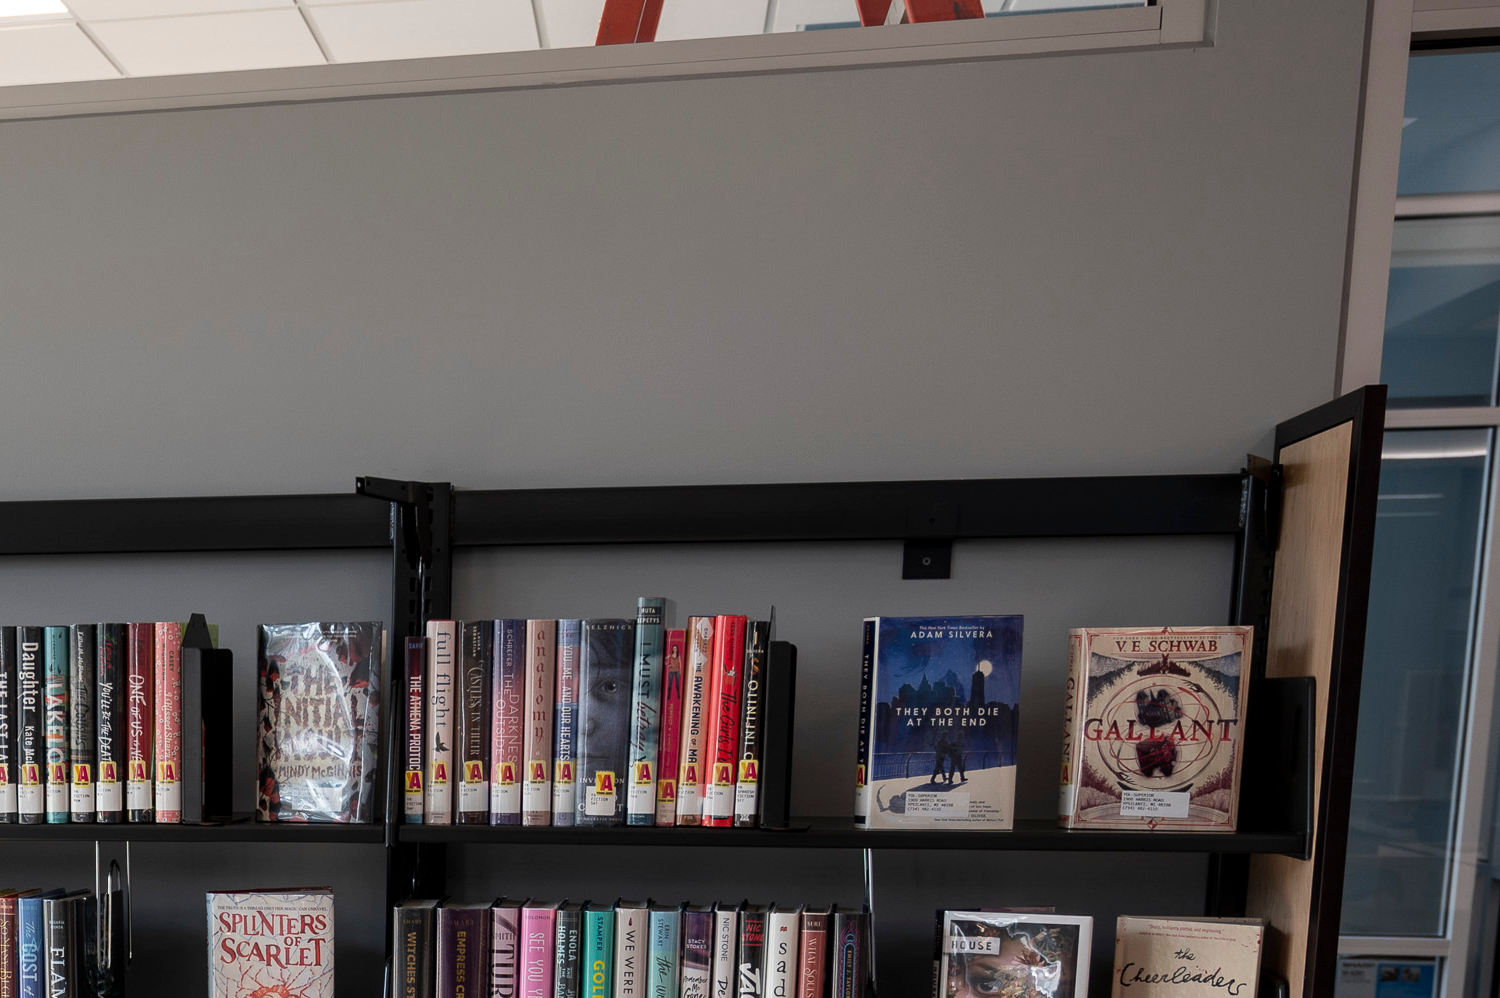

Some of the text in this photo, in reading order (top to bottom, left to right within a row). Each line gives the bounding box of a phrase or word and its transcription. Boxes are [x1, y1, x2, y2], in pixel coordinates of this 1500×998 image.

[1116, 641, 1218, 652] V. E. SCHWAB
[19, 643, 38, 712] Daughter
[432, 632, 451, 728] full flight
[692, 676, 702, 734] AWAKENING
[1085, 718, 1238, 741] GALLANT
[279, 764, 363, 779] MINDY McGINIS
[219, 911, 327, 936] SPLINTERS
[220, 937, 326, 969] SCARLET
[284, 937, 302, 946] OF
[457, 931, 466, 981] EMPRESS
[569, 930, 577, 961] ENOLA
[625, 930, 635, 951] WE
[950, 940, 992, 951] HOUSE
[1175, 949, 1196, 962] the
[407, 932, 416, 983] WITCHES
[528, 933, 545, 981] SEE YOU
[624, 956, 635, 994] WERE
[1119, 963, 1247, 996] Cheerleaders
